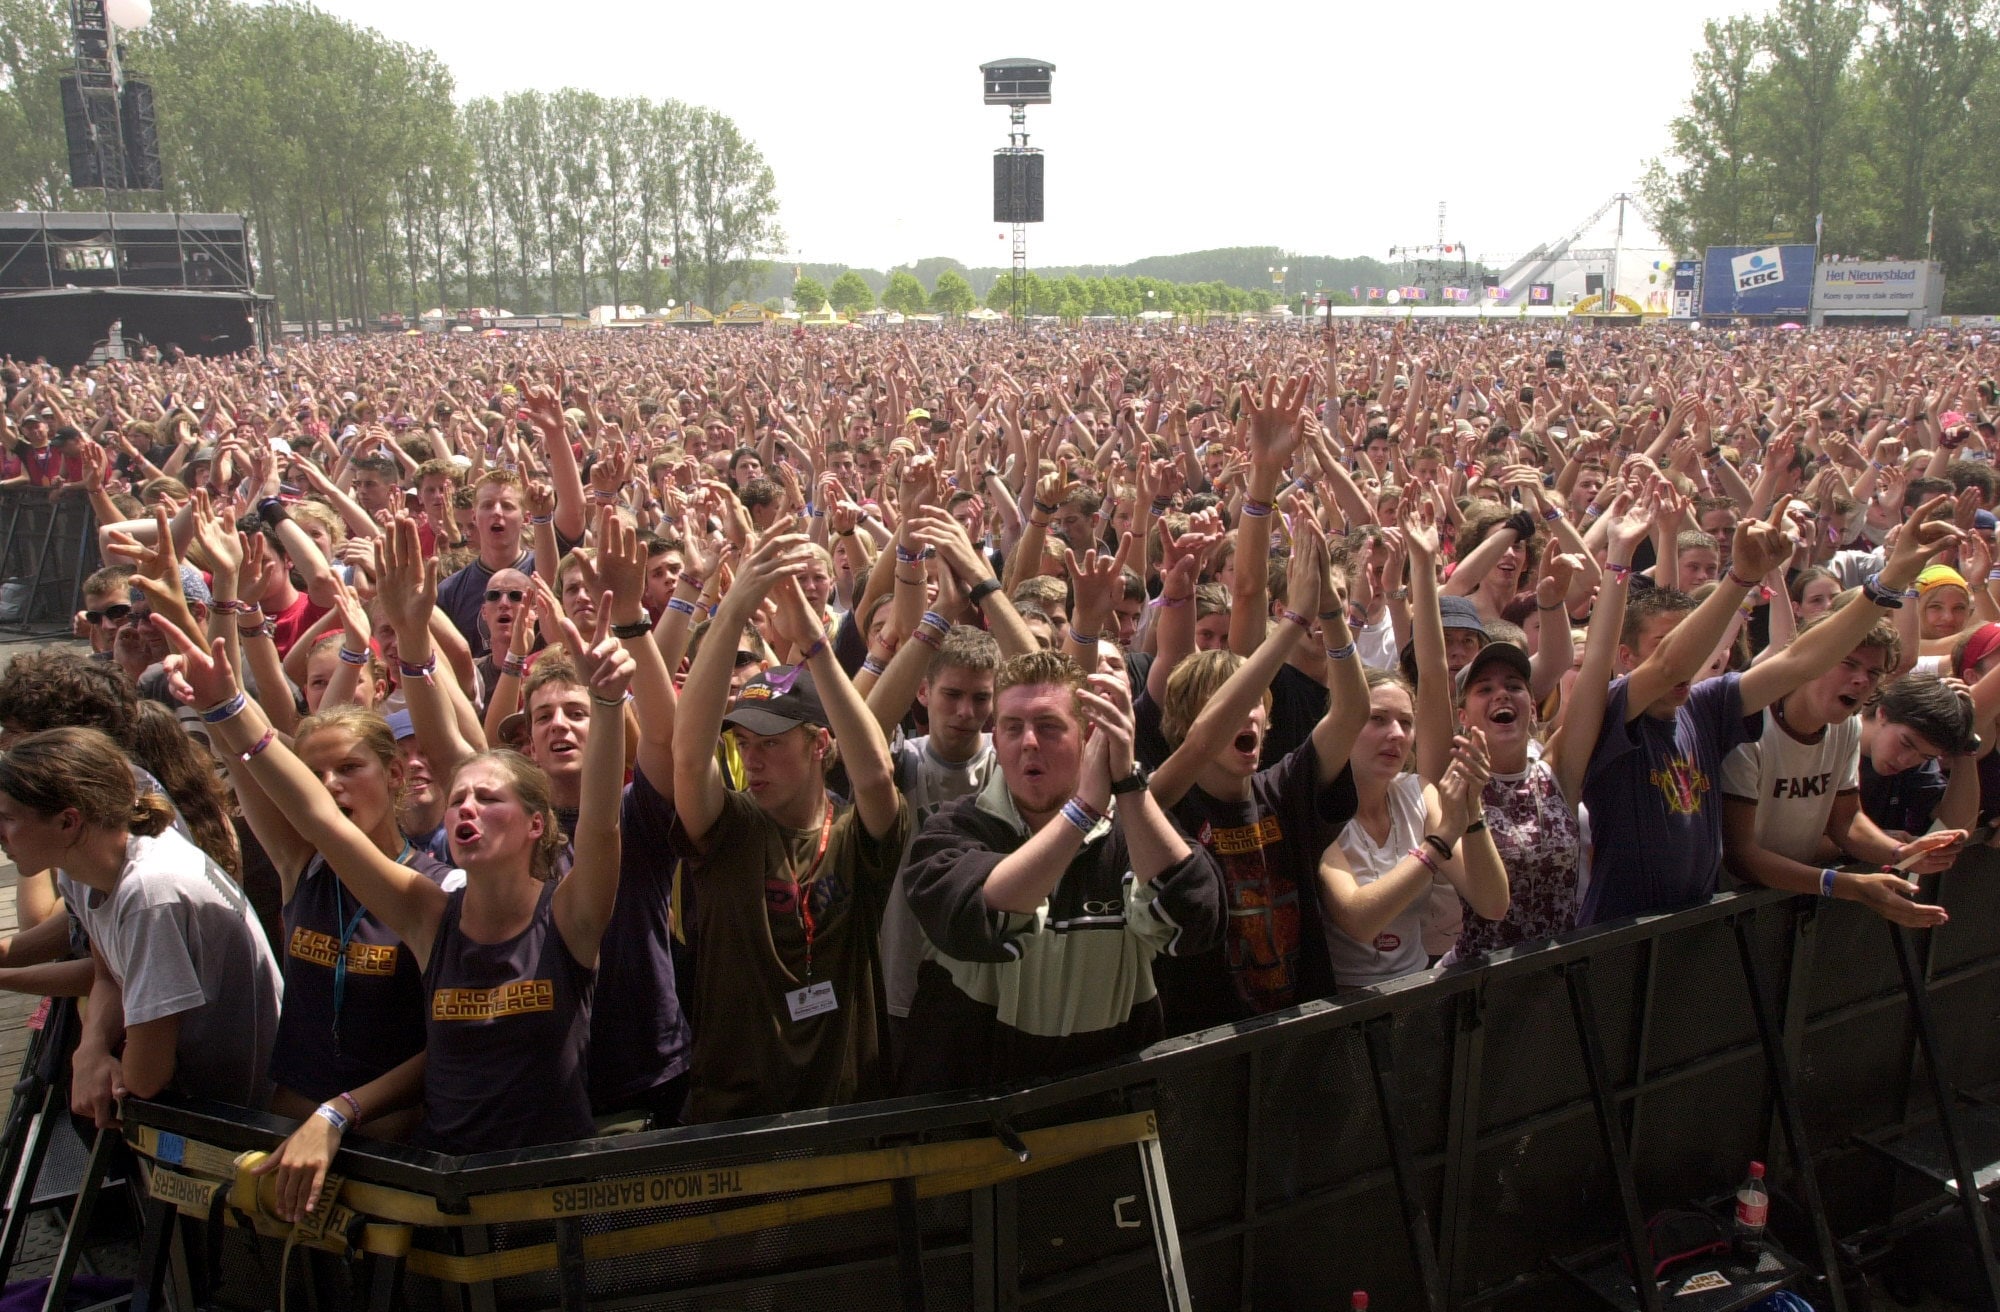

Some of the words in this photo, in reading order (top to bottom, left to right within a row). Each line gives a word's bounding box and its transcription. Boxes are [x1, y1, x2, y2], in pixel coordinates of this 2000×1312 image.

[1739, 270, 1779, 288] KBC
[1826, 270, 1845, 281] Het
[1848, 269, 1916, 281] Nieuwsblad
[1823, 292, 1841, 300] Kom
[1773, 772, 1832, 799] FAKE
[506, 982, 549, 999] VAN
[153, 1171, 211, 1206] BARRIERS
[651, 1175, 703, 1201] MOJO
[709, 1170, 743, 1194] THE
[552, 1180, 645, 1213] BARRIERS
